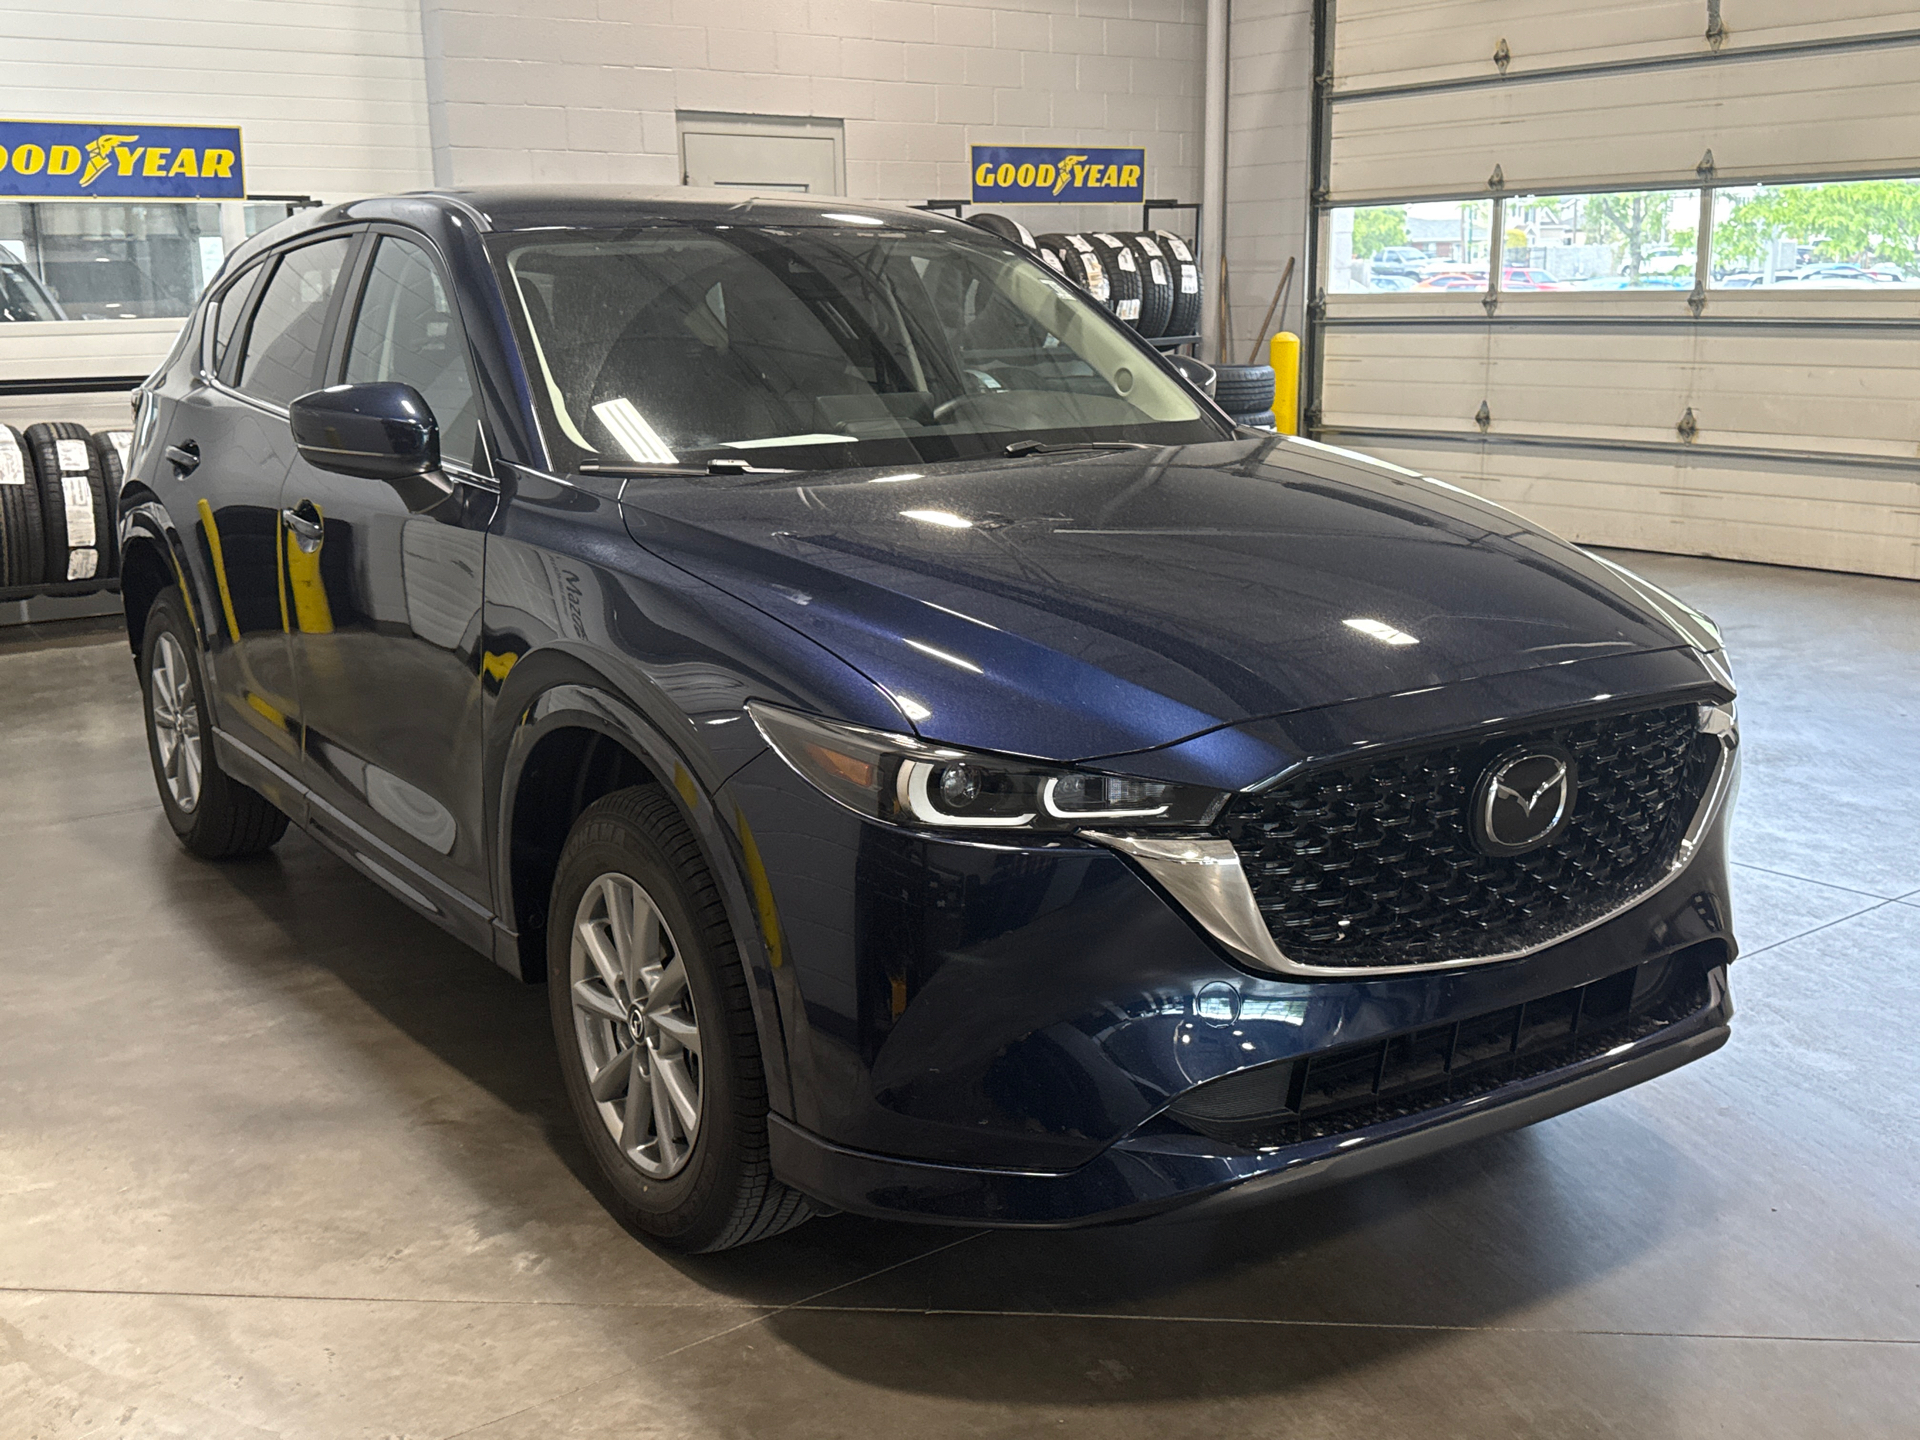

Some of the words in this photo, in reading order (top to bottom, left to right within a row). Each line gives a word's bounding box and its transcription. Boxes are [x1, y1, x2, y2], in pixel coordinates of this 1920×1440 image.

[0, 144, 82, 176] OD
[116, 147, 235, 178] YEAR
[975, 163, 1055, 188] GOOD
[1074, 164, 1141, 188] YEAR
